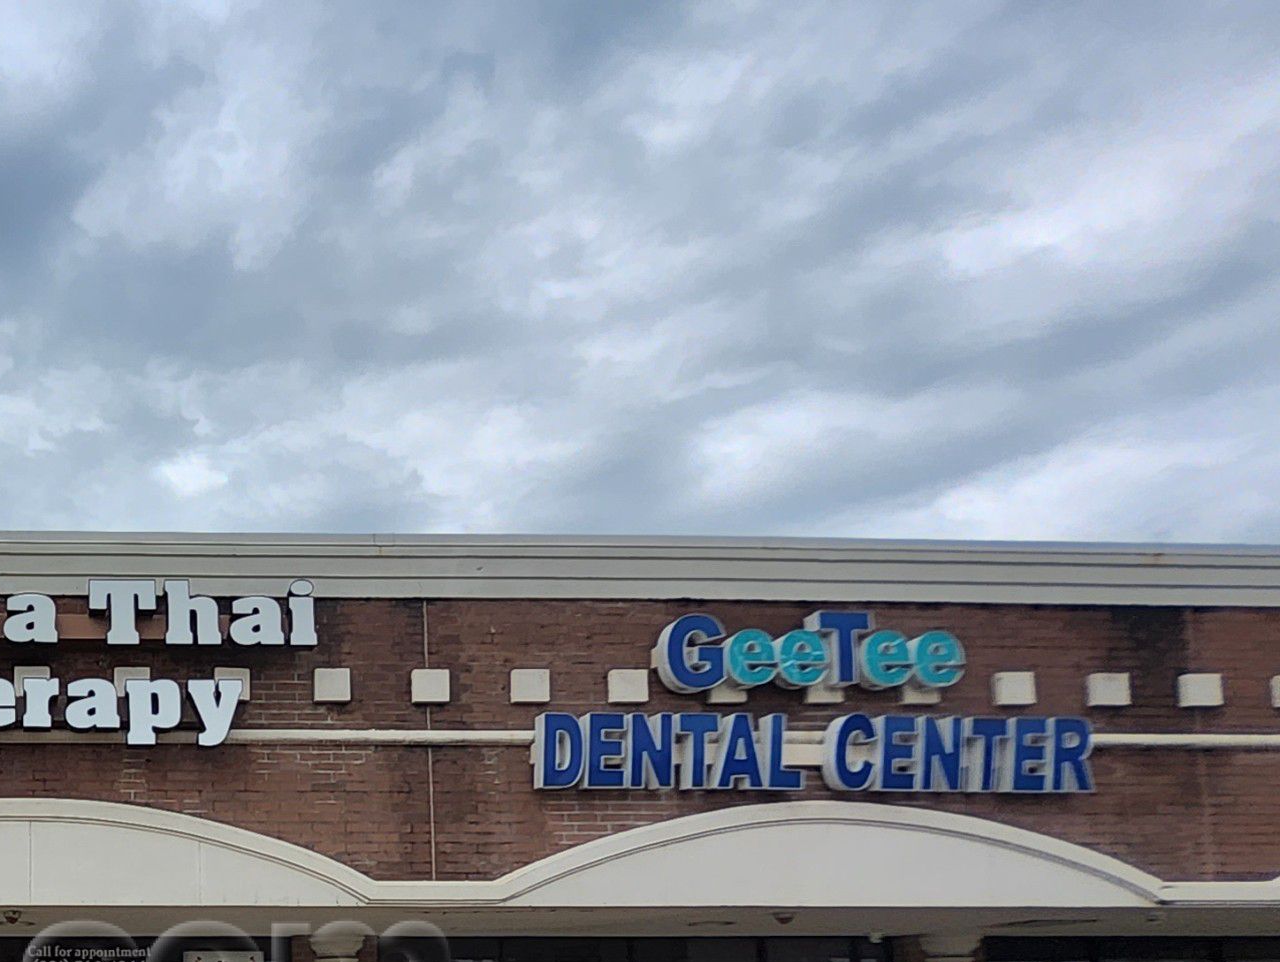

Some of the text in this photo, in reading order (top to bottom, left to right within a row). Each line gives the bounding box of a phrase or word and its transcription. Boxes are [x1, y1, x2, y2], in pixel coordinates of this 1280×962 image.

[88, 577, 318, 646] Thai
[660, 611, 965, 691] GeeTee
[534, 712, 1095, 793] DENTAL CENTER
[27, 946, 151, 960] Call for appointment
